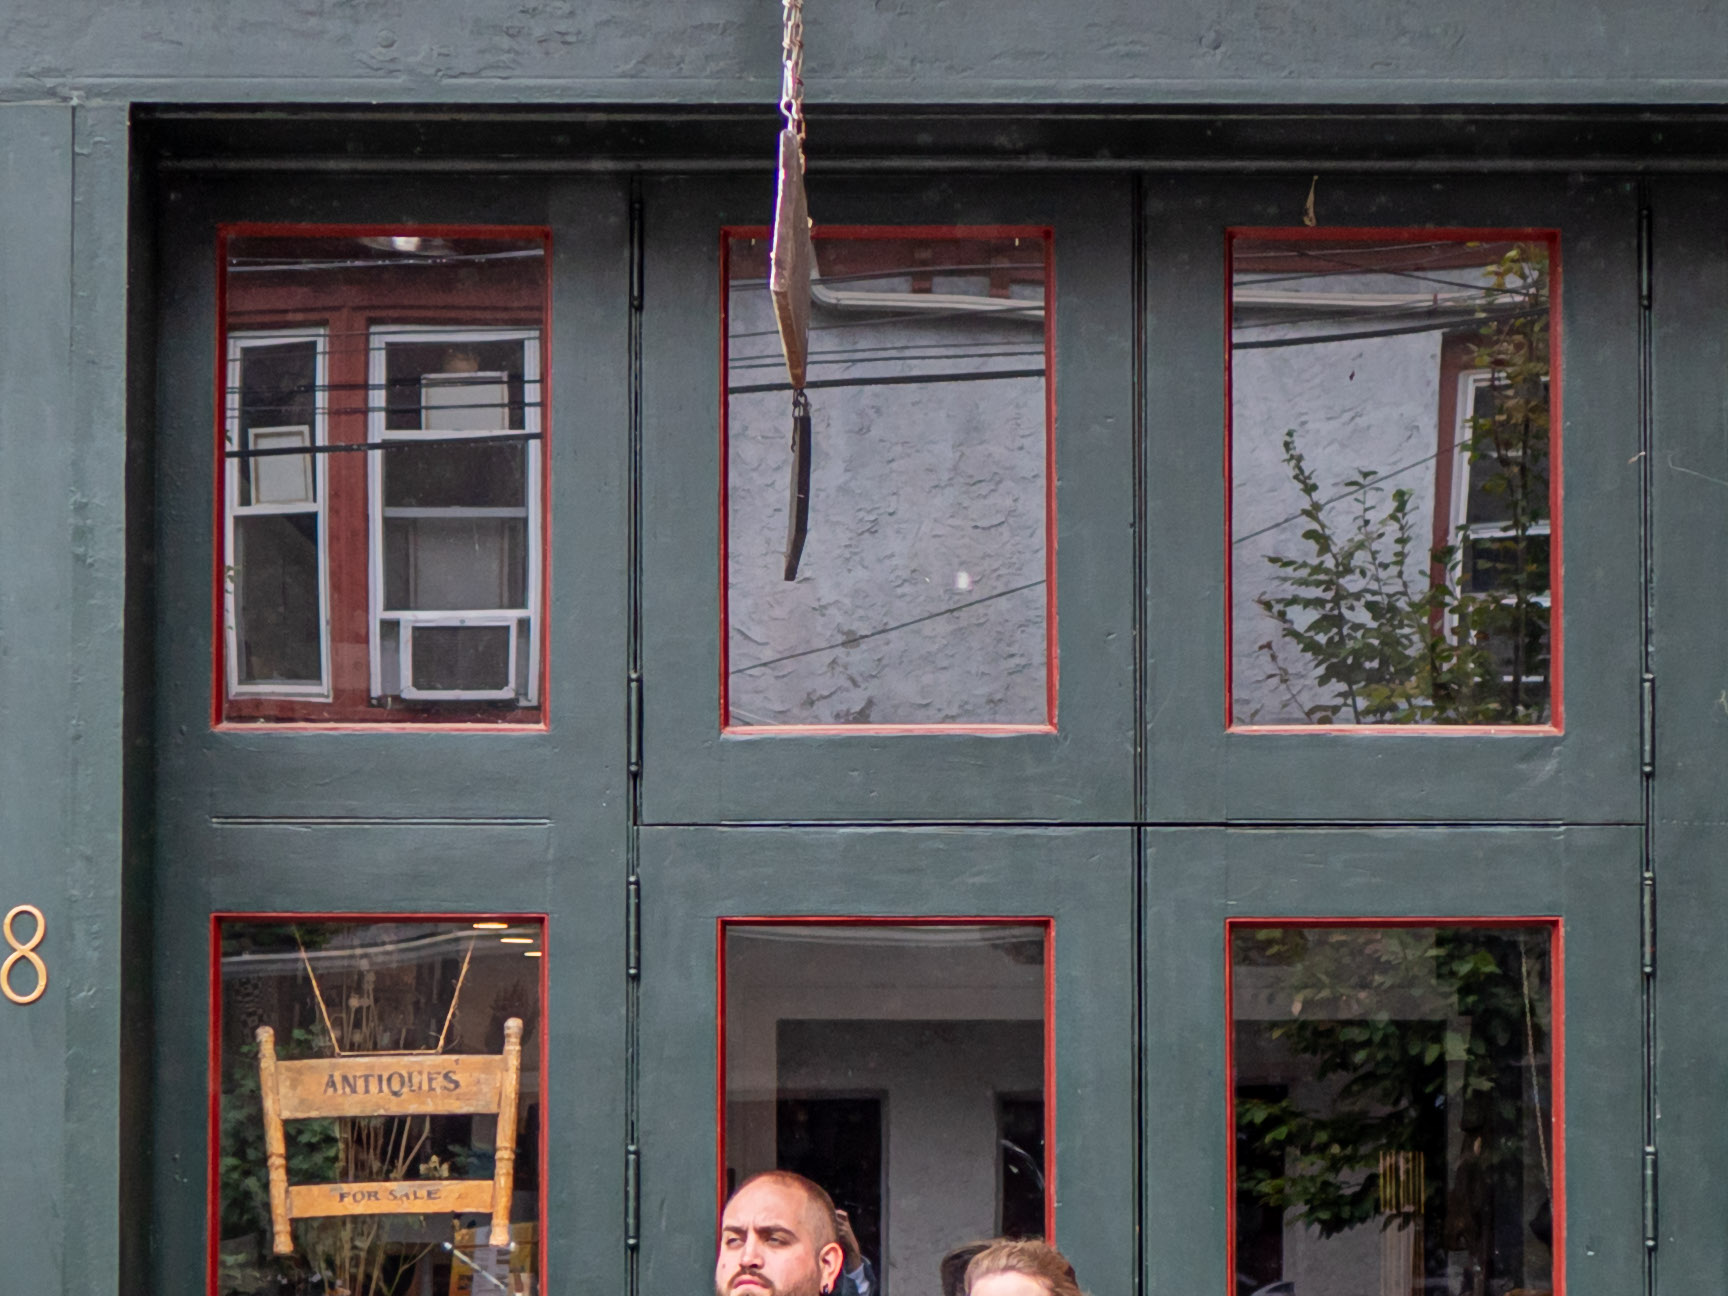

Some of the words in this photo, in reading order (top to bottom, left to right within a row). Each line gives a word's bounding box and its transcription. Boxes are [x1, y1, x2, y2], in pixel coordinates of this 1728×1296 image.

[0, 904, 48, 1004] 8
[323, 1069, 461, 1096] ANTIQUES
[337, 1190, 379, 1204] FOR
[388, 1188, 442, 1202] SALE
